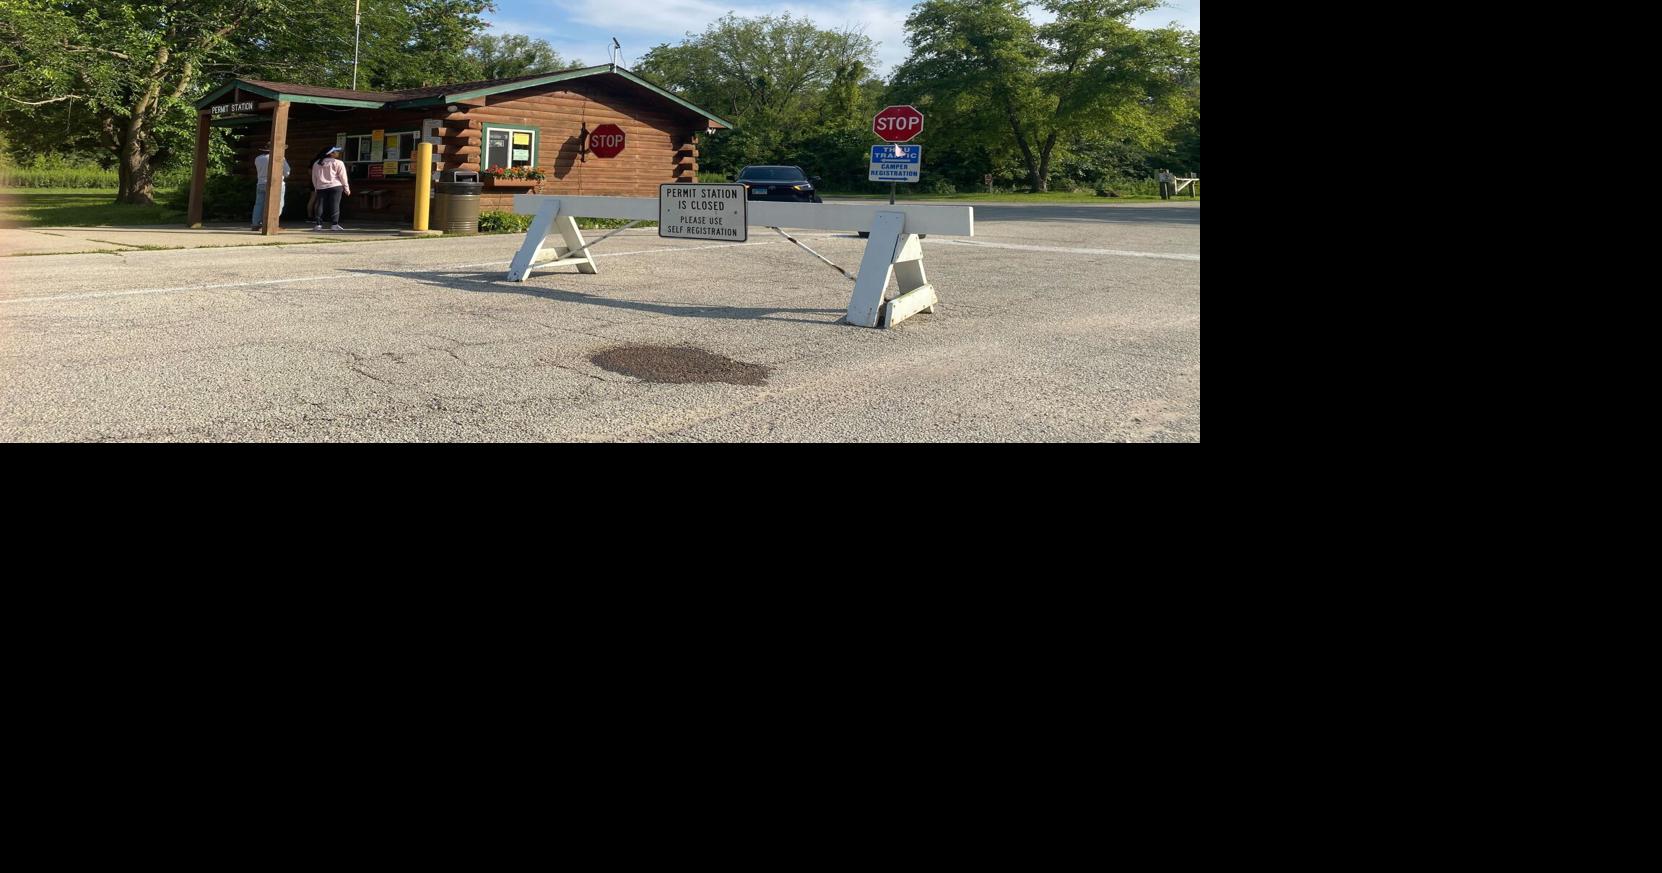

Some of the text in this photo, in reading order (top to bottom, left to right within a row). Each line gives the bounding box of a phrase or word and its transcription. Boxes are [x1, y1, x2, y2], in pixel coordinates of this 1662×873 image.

[211, 102, 253, 114] PERMIT STATION
[877, 116, 919, 130] STOP
[591, 134, 624, 148] STOP
[666, 188, 737, 199] PERMIT STATION
[678, 200, 725, 211] IS CLOSED
[680, 216, 723, 225] PLEASE USE
[667, 226, 737, 237] SELF REGISTRATION
